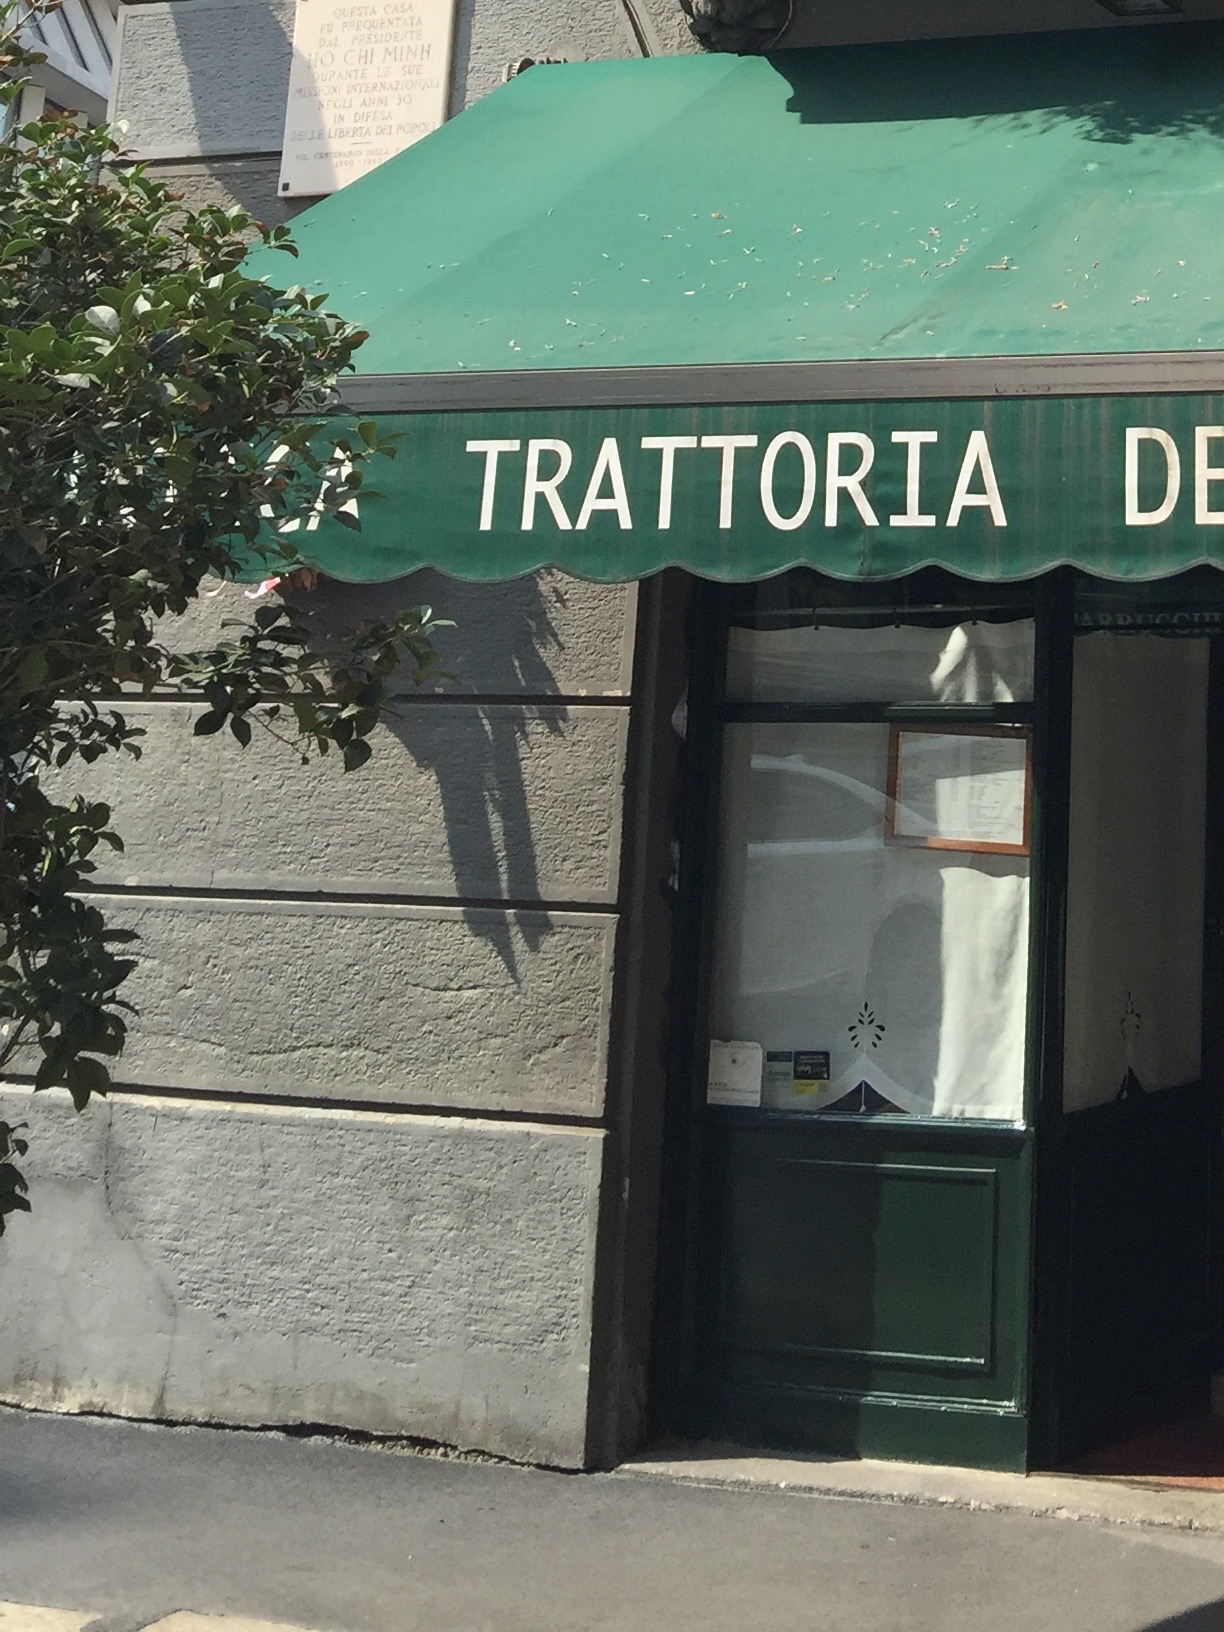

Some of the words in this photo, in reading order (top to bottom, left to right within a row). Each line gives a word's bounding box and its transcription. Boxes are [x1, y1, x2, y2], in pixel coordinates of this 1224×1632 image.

[333, 5, 376, 19] QUESTA
[383, 3, 414, 15] CASA
[320, 21, 333, 33] FU
[319, 36, 341, 48] DAL
[351, 30, 423, 47] PRESIDENTE
[308, 51, 334, 69] HO
[343, 48, 374, 66] CHI
[383, 43, 432, 65] MINH
[313, 68, 367, 82] DURANTE
[377, 66, 392, 78] LE
[401, 64, 423, 77] SUE
[346, 78, 440, 95] INTERNAZIONALI
[360, 95, 388, 107] ANNI
[333, 112, 345, 124] IN
[353, 110, 393, 124] DIFESA
[466, 429, 1008, 532] TRATTORIA
